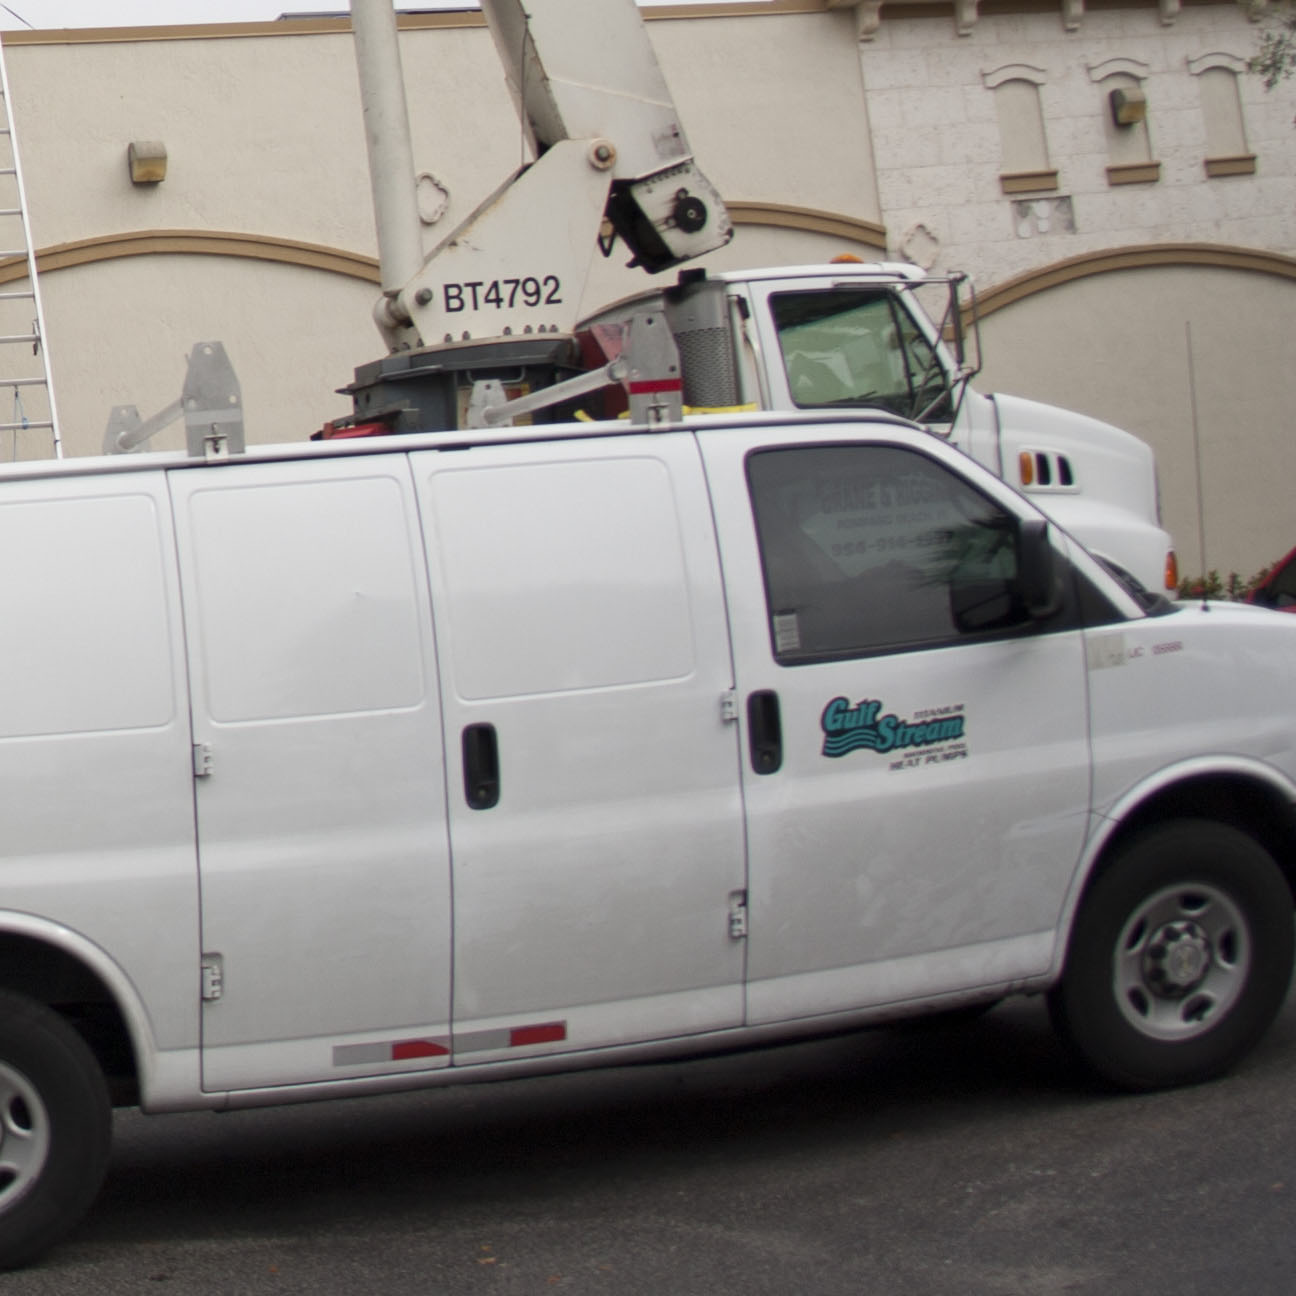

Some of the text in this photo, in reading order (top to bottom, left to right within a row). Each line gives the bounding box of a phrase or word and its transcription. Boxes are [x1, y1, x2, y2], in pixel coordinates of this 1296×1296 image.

[443, 275, 562, 312] BT4792
[821, 696, 882, 734] Gulf
[876, 714, 965, 753] Stream
